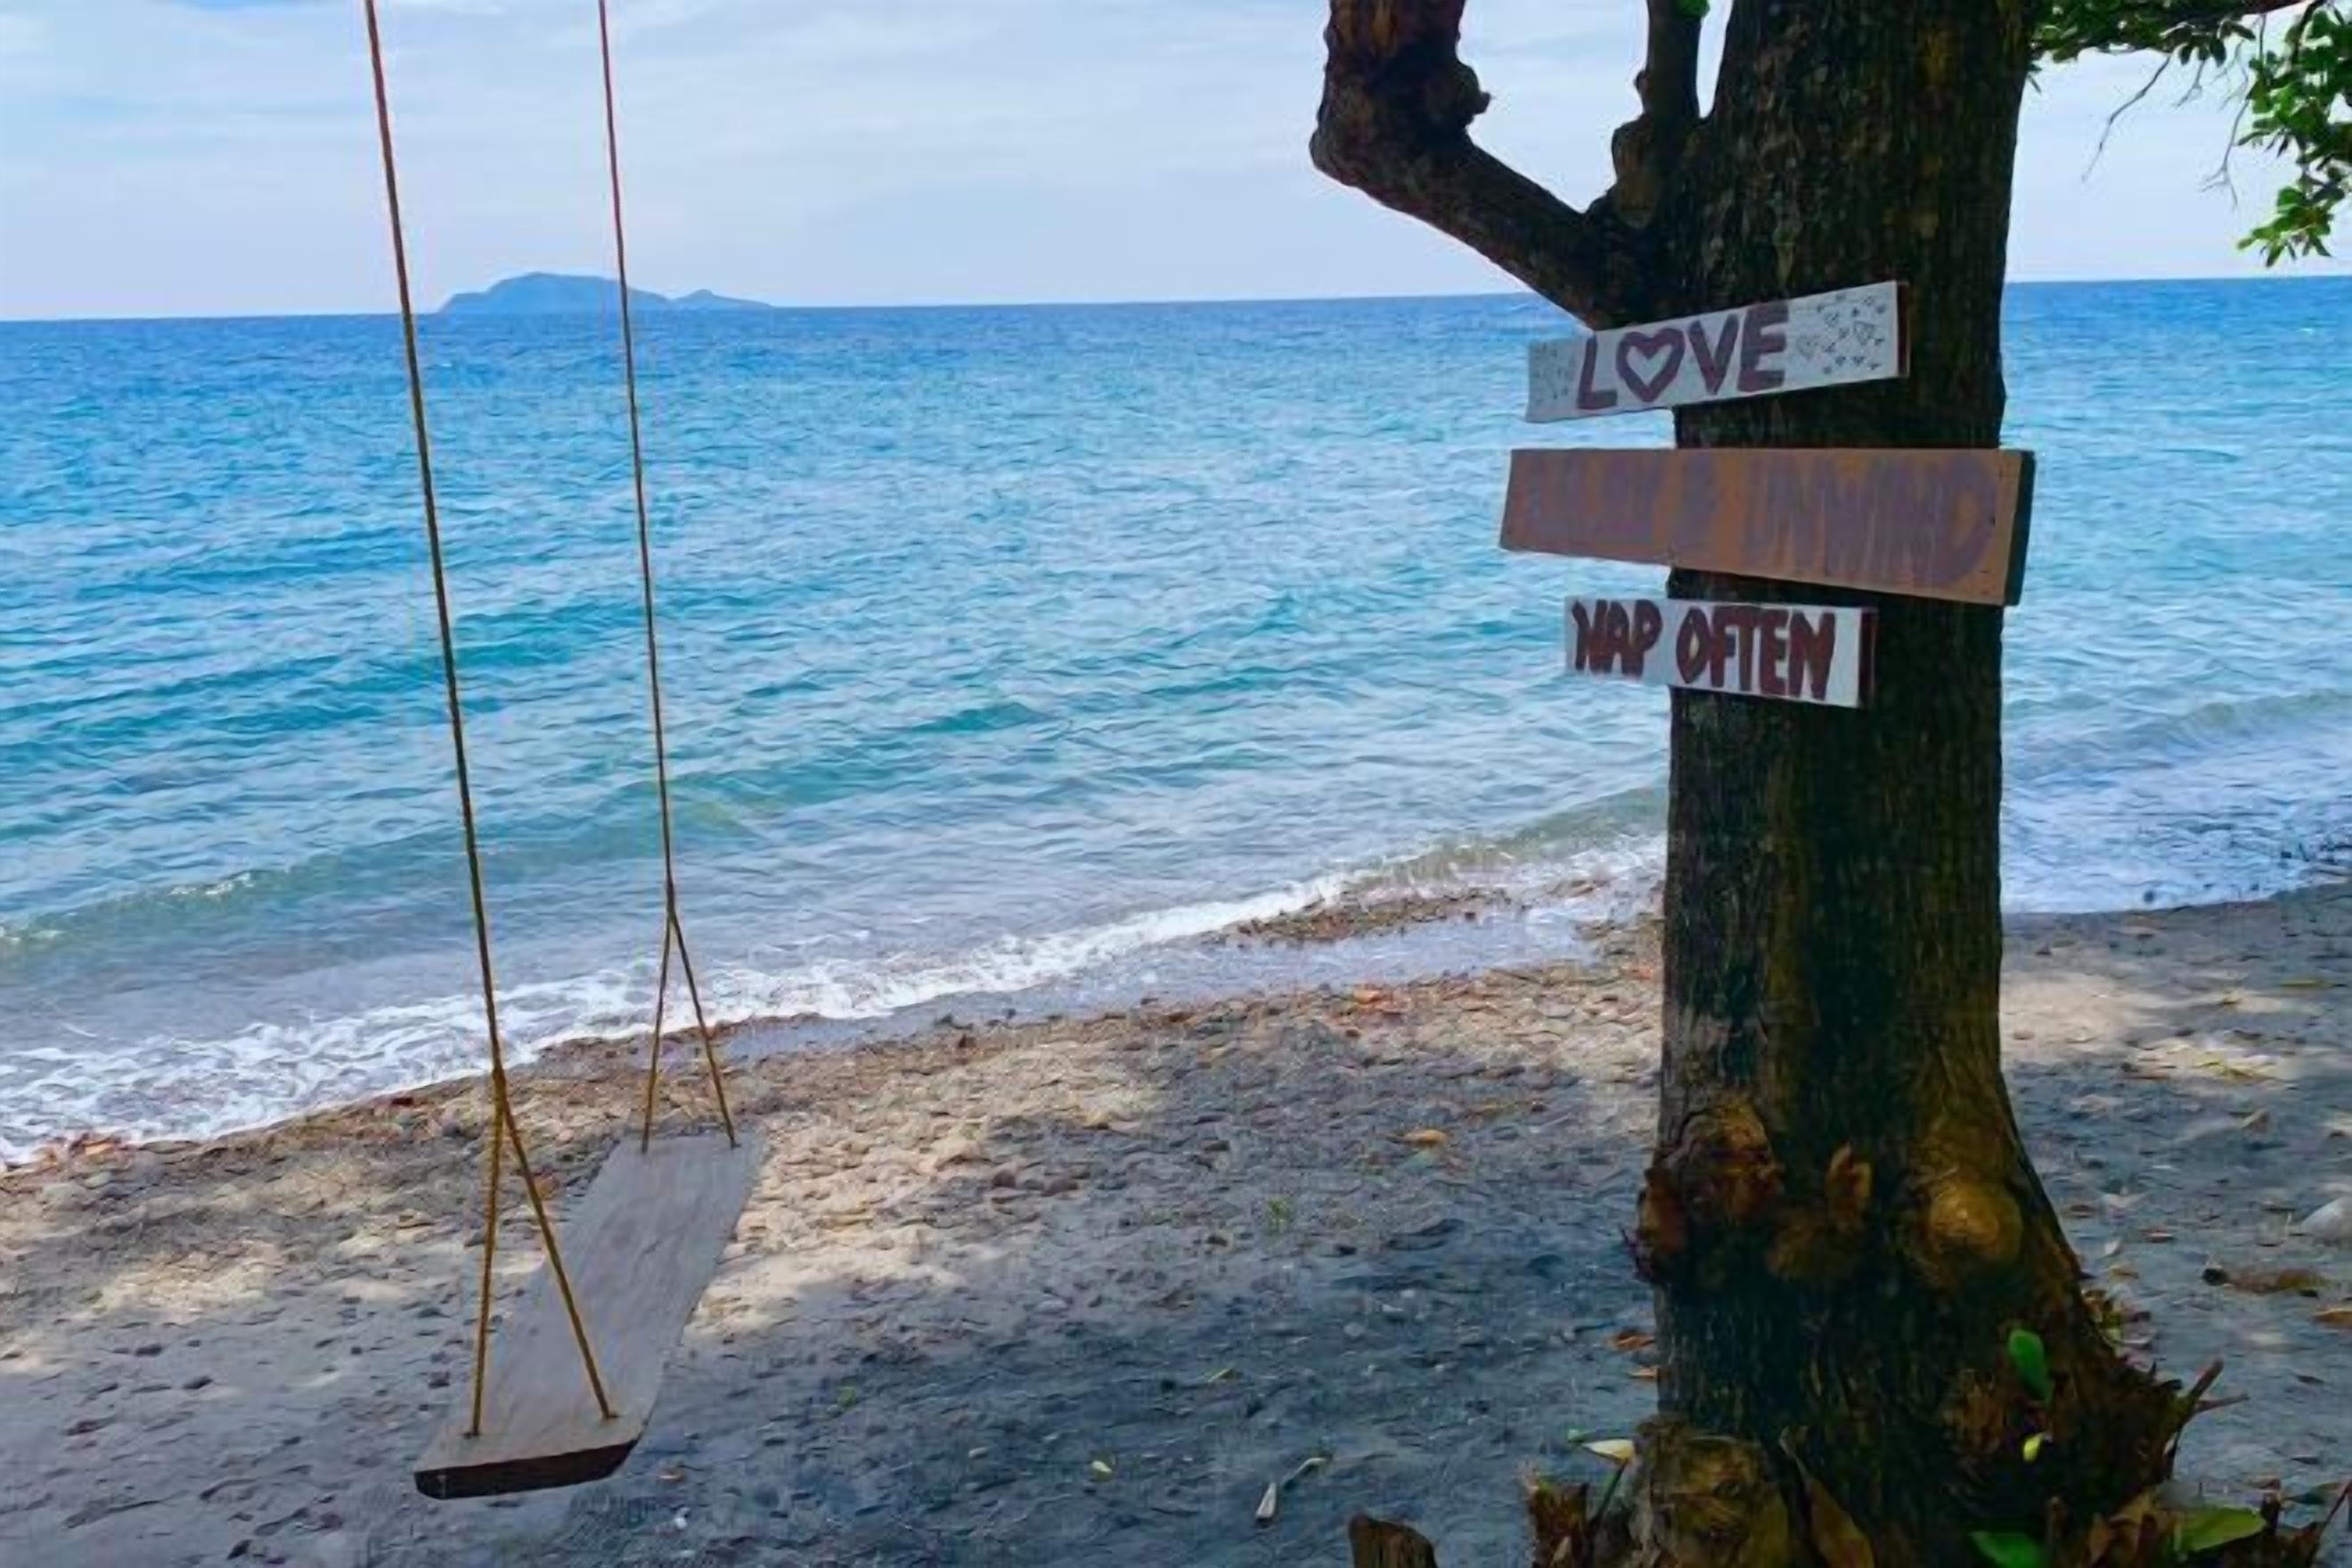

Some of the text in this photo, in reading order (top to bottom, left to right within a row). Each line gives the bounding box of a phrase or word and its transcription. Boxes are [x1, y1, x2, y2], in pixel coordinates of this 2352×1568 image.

[1577, 299, 1789, 411] LOVE
[1572, 599, 1835, 700] NAP OFTEN
